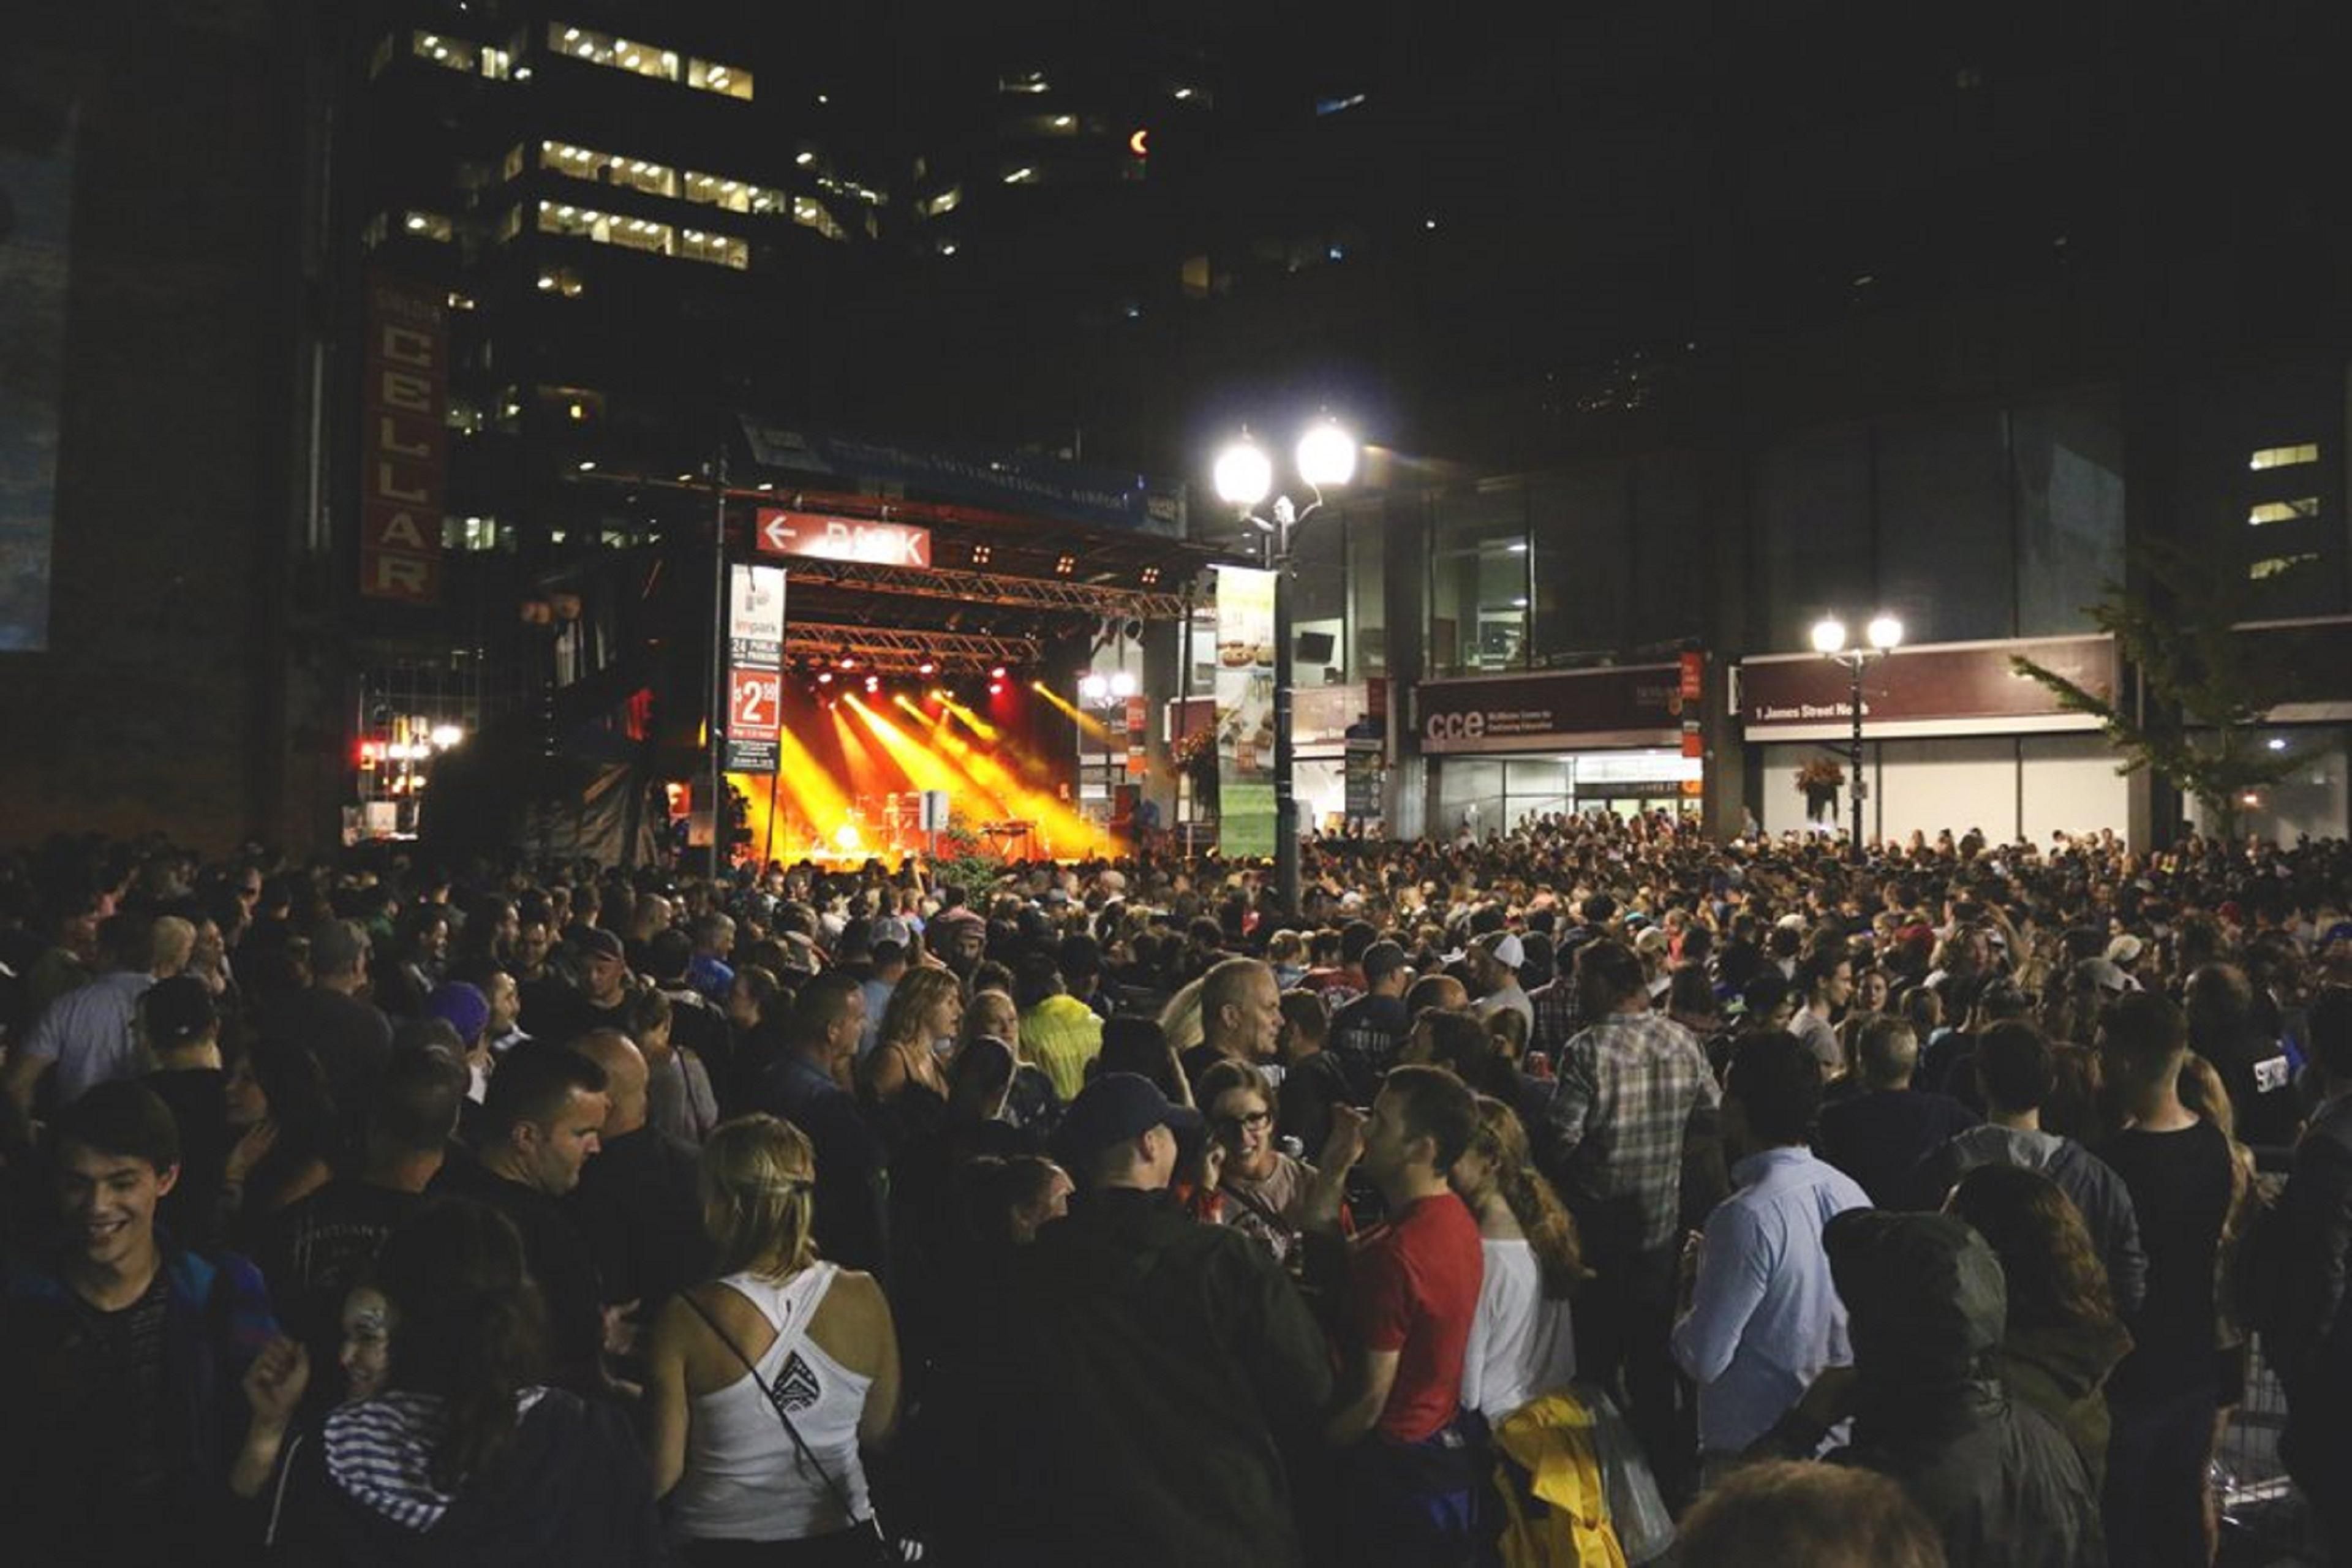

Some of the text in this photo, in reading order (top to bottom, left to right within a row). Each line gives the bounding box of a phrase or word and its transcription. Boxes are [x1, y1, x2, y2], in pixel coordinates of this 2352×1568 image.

[377, 326, 433, 593] CELLAR
[826, 521, 923, 565] PAK
[1427, 710, 1485, 739] cce
[1756, 701, 1869, 719] 1 James Street Noh
